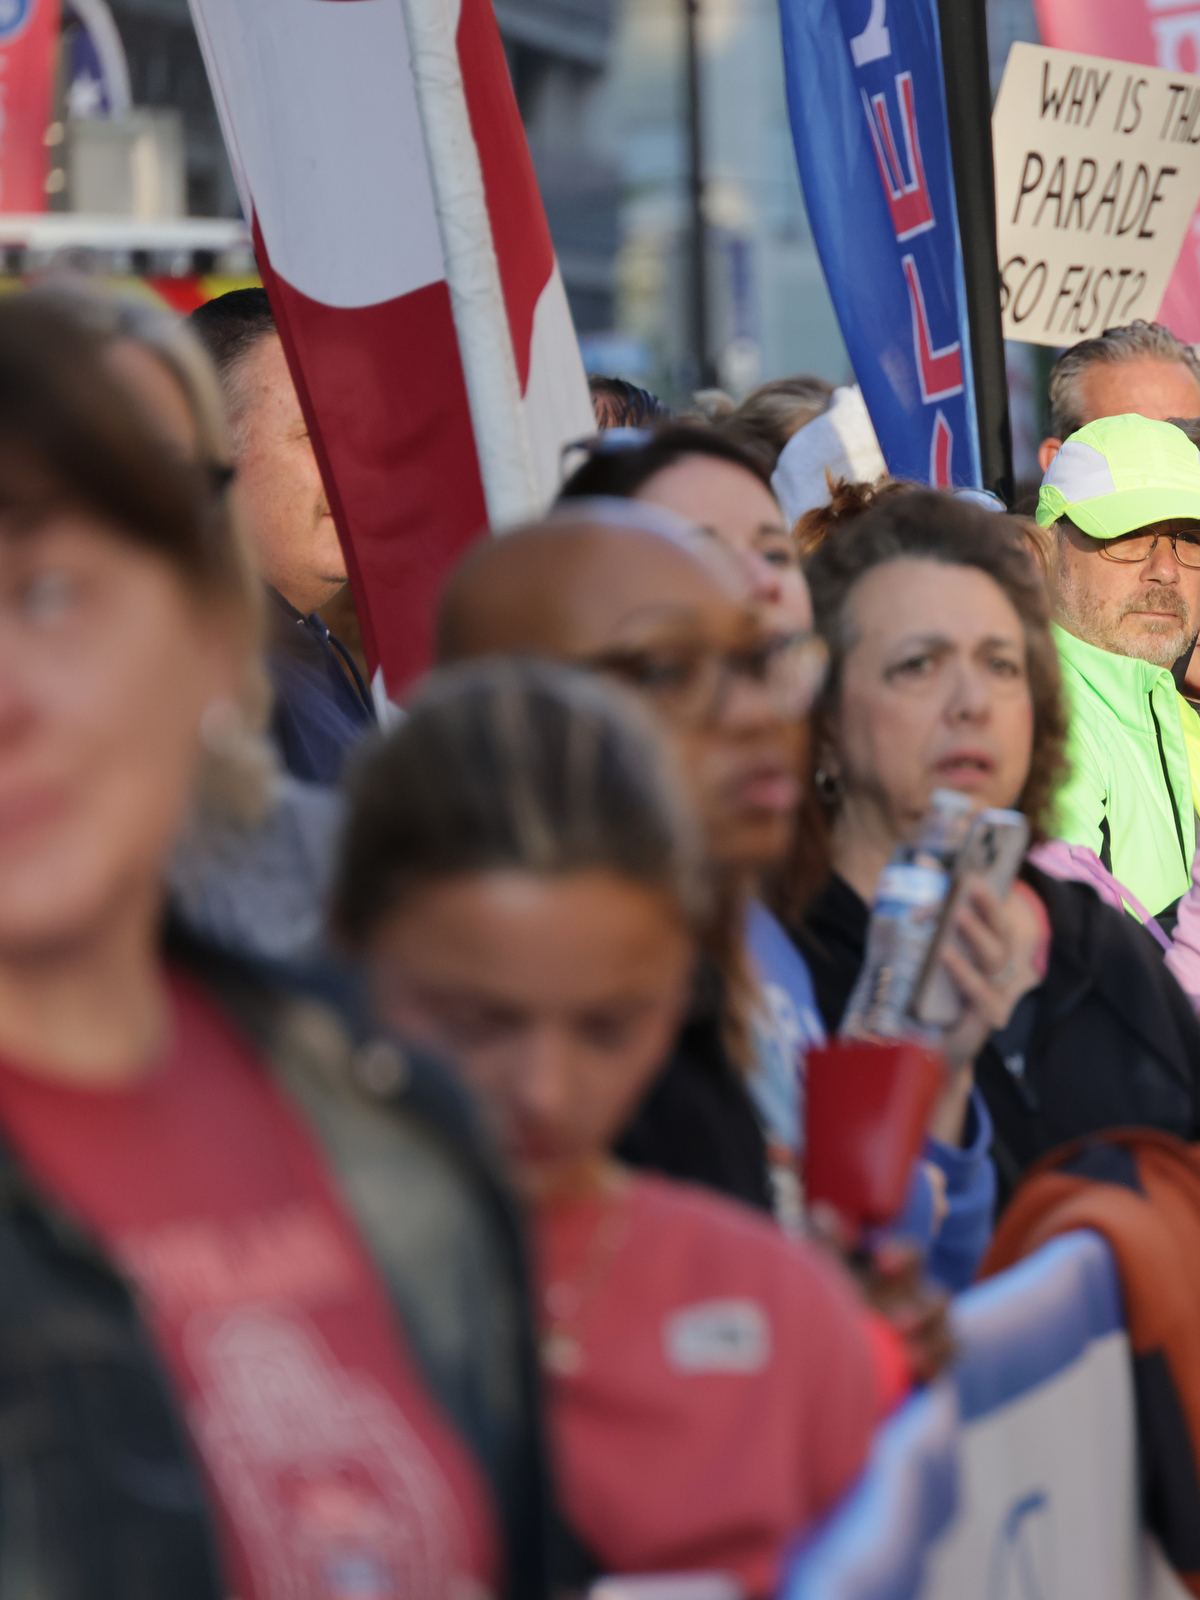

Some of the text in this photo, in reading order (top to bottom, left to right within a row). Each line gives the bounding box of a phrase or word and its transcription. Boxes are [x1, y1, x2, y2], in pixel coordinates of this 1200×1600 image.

[1039, 60, 1112, 128] WHY
[1114, 75, 1149, 134] IS
[1011, 151, 1178, 239] PARADE
[999, 255, 1147, 335] SO FAST?
